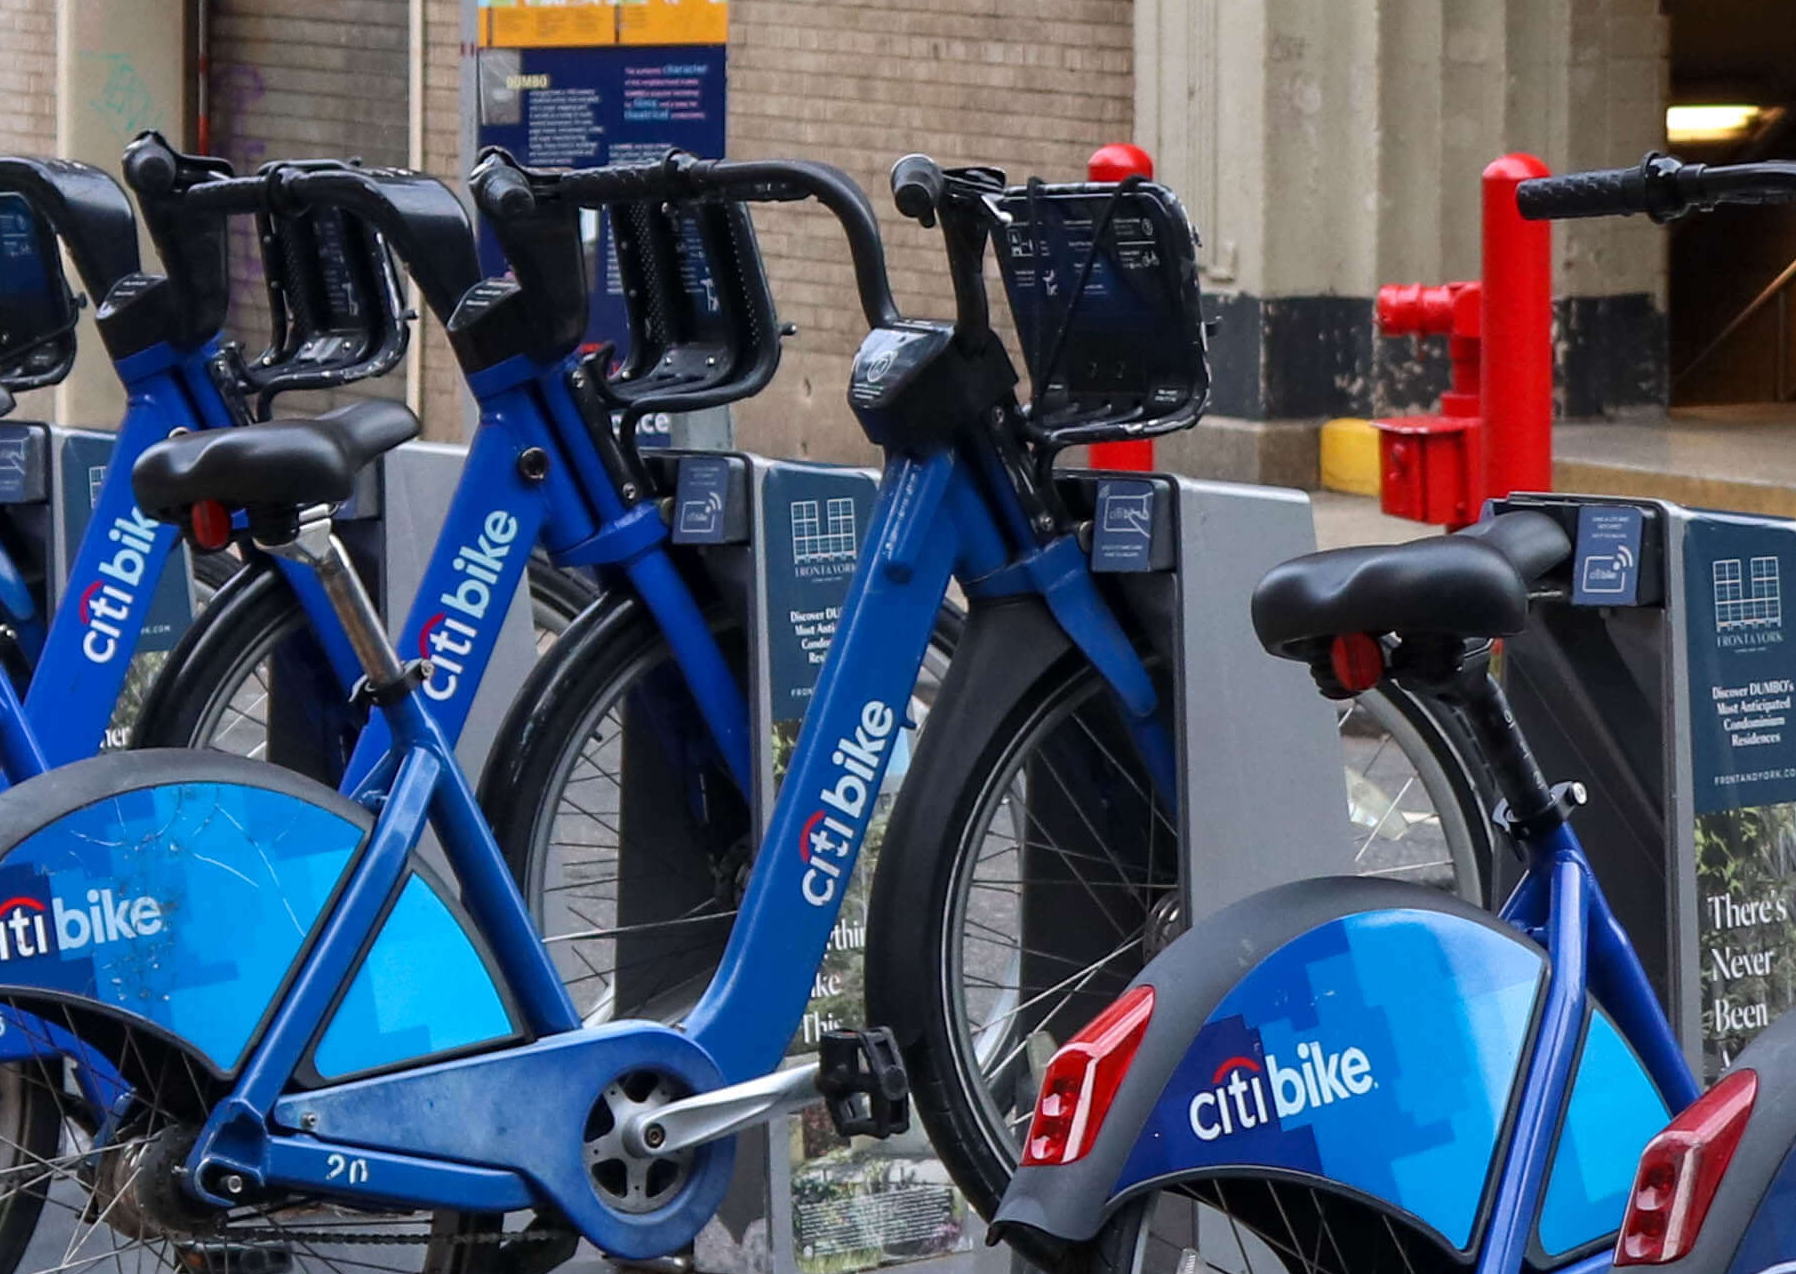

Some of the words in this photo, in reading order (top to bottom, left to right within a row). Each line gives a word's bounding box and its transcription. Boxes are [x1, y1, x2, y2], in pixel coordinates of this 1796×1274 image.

[506, 74, 551, 90] DUMBO
[98, 505, 160, 586] bik
[79, 580, 134, 664] citi
[418, 612, 478, 702] citi
[452, 509, 518, 621] bike
[790, 609, 825, 623] Discover
[1712, 685, 1748, 700] Discover
[1749, 679, 1795, 696] DUMBO's
[1716, 701, 1739, 715] Most
[1741, 696, 1792, 714] Anticipated
[1723, 715, 1786, 732] Condominium
[1731, 732, 1781, 747] Residences
[820, 700, 894, 819] bike
[800, 809, 854, 907] citi
[53, 888, 163, 952] bike
[1707, 889, 1788, 929] There's
[1711, 946, 1775, 982] Never
[1715, 998, 1769, 1033] Been
[1189, 1055, 1268, 1142] citi
[1265, 1042, 1377, 1119] bike
